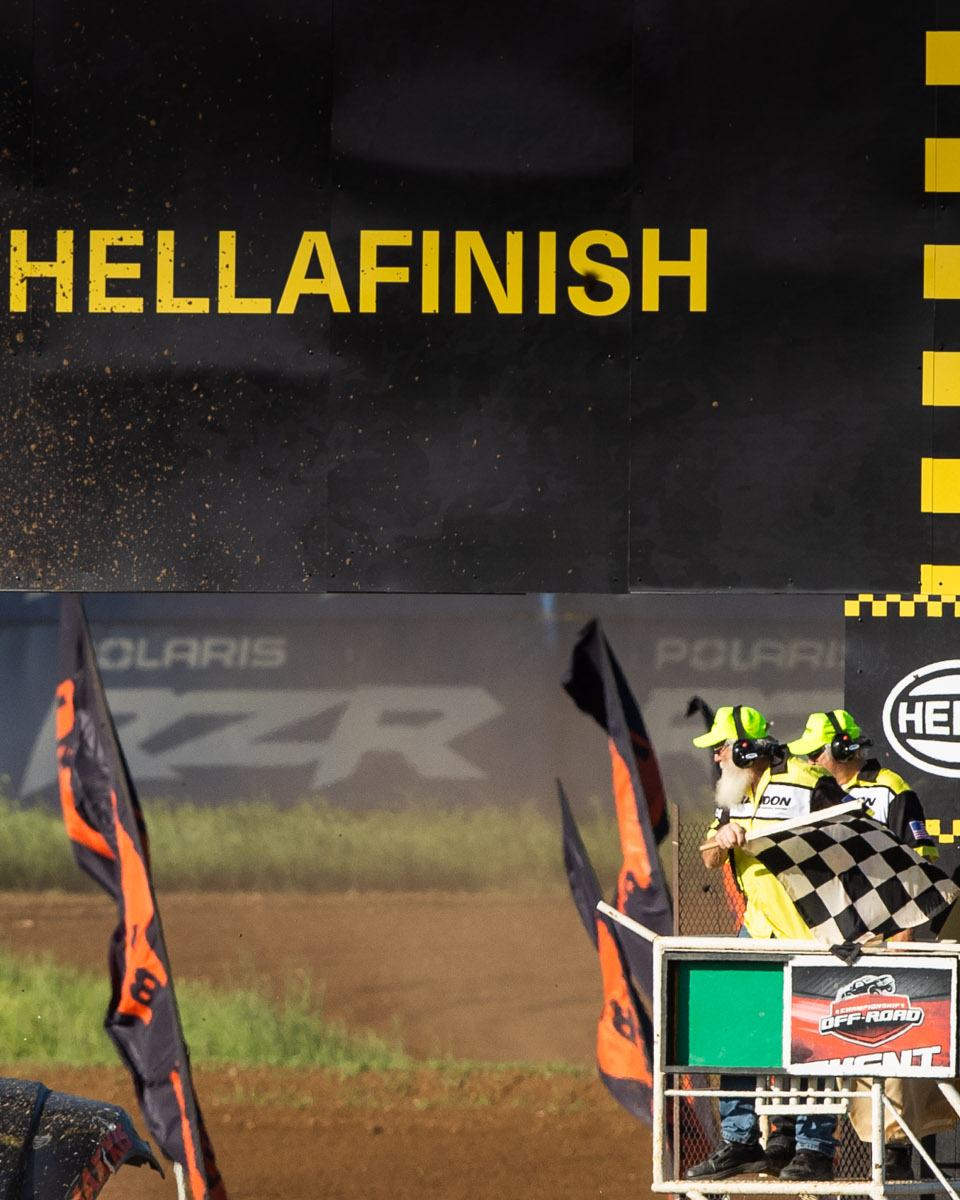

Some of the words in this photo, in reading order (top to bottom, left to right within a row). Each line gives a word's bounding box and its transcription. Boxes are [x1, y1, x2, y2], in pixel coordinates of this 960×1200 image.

[96, 636, 288, 670] OLARIS
[656, 637, 844, 671] POLARI
[821, 1008, 922, 1031] OFF-ROAD
[840, 1003, 900, 1014] CHAMPIONSHIP
